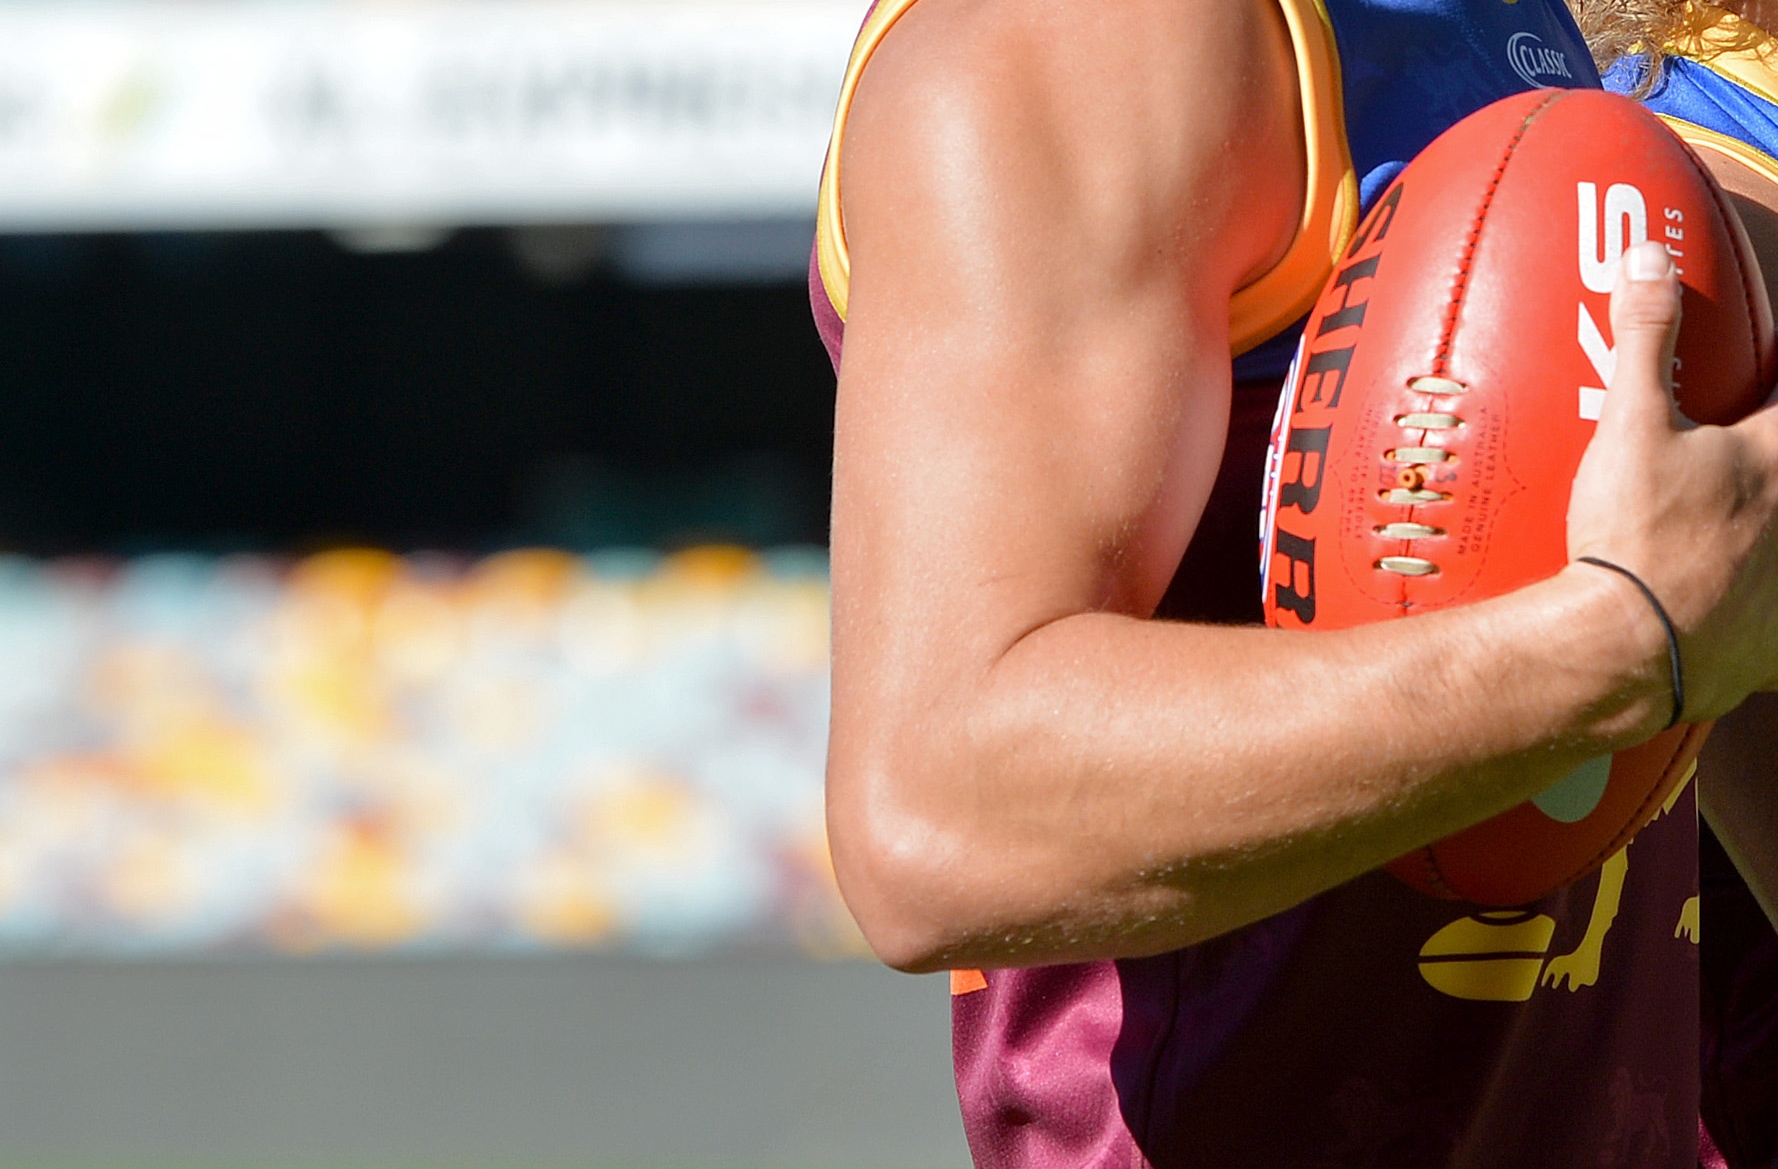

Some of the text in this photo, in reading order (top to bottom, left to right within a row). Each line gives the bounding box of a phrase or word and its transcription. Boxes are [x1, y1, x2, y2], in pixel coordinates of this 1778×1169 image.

[1519, 44, 1572, 79] CLASSIC
[1456, 407, 1488, 555] MADE IN AUSTRALIA
[1471, 414, 1500, 553] GENUINE LEATHER
